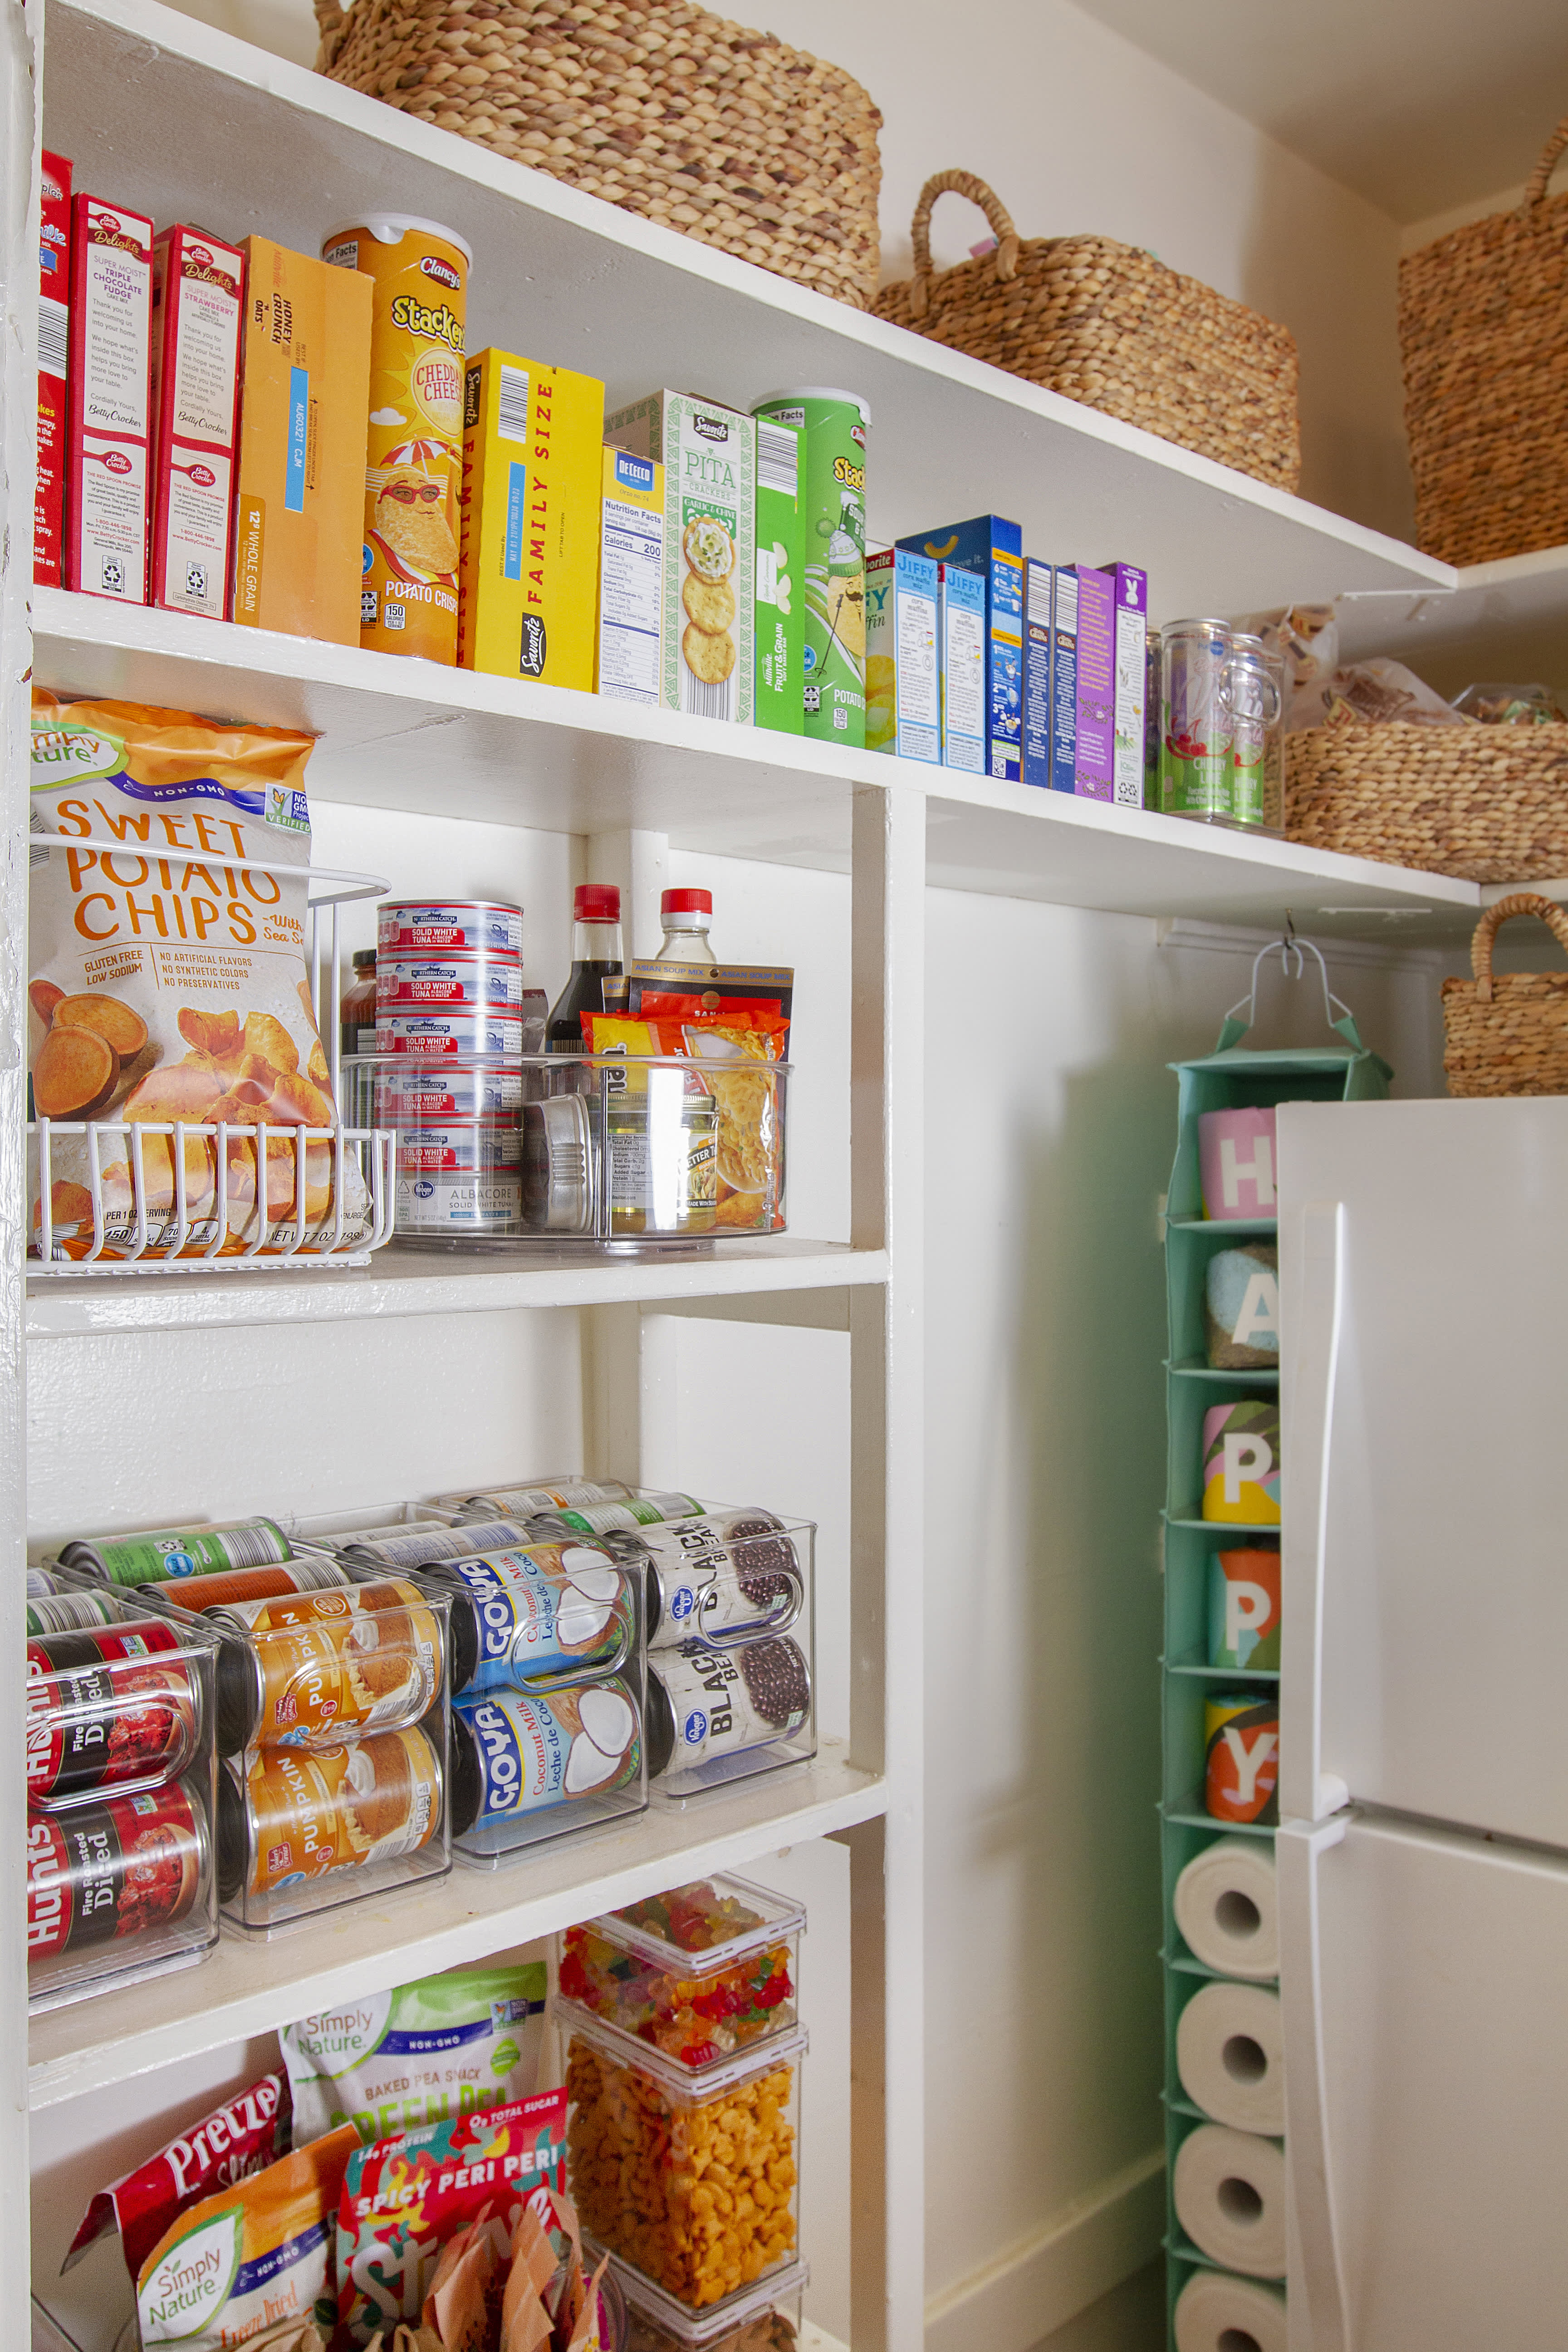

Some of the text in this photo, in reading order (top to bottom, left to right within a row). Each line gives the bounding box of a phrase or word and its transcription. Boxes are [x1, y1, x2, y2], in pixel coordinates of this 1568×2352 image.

[94, 230, 139, 254] Delights
[335, 245, 357, 257] Facts
[94, 255, 116, 269] SUPER
[420, 257, 461, 288] Clancy's
[93, 273, 142, 294] CHOCOLATE
[105, 268, 131, 282] TRIPLE
[185, 264, 232, 289] Delights
[104, 284, 131, 299] FUDGE
[187, 284, 208, 298] SUPER
[93, 298, 111, 309] Thank
[185, 293, 234, 317] STRAWBERRY
[255, 299, 263, 323] OATS
[92, 319, 118, 332] into your
[93, 309, 124, 325] welcoming
[272, 293, 282, 344] CRUNCH
[283, 299, 292, 343] HONEY
[92, 344, 134, 363] inside this box
[103, 337, 118, 348] hope
[120, 344, 138, 354] what's
[91, 365, 120, 378] more love
[92, 354, 137, 374] helps bring
[106, 379, 122, 389] table.
[91, 392, 137, 412] Cordially Yours,
[180, 400, 205, 413] Cordially
[42, 427, 51, 436] the
[535, 383, 553, 460] SIZE
[106, 458, 129, 471] Crocker
[110, 454, 126, 466] Betty
[294, 448, 303, 467] CJM
[40, 467, 54, 477] heat.
[685, 451, 736, 489] PITA
[106, 476, 122, 484] SPOON
[122, 480, 141, 489] PROMISE
[689, 482, 730, 500] CRACKERS
[605, 500, 661, 524] Nutrition Facts
[684, 498, 736, 519] GARLIC CHIVE
[36, 525, 53, 536] spray.
[95, 519, 132, 531] 1-800-446-1898
[87, 529, 140, 545] www.BettyCrocker.com
[528, 476, 549, 605] FAMILY
[605, 534, 632, 549] Calories
[34, 546, 44, 554] and
[644, 544, 661, 556] 200
[46, 559, 55, 567] are
[245, 529, 260, 612] WHOLE GRAIN
[897, 555, 934, 579] JIFFY
[947, 572, 982, 594] JIFFY
[386, 580, 457, 616] POTATO CRISPS
[388, 605, 403, 616] 150
[522, 617, 544, 673] Savoritz
[833, 689, 860, 708] POTATO
[836, 709, 846, 719] 150
[153, 783, 225, 797] NON-GMO
[57, 798, 246, 858] SWEET
[269, 814, 310, 831] VERIFIED
[66, 847, 281, 904] POTATO
[74, 890, 257, 945] CHIPS
[264, 926, 289, 942] Sea
[84, 950, 144, 972] GLUTEN FREE
[159, 952, 252, 966] NO ARTIFICIAL FLAVORS
[86, 964, 143, 985] LOW SODIUM
[162, 964, 249, 979] NO SYNTHETIC COLORS
[749, 971, 772, 980] SOUP
[177, 978, 240, 990] PRESERVATIVES
[432, 982, 456, 990] WHITE
[1220, 1136, 1275, 1207] H
[416, 1182, 432, 1196] Kroger
[106, 1211, 121, 1220] PER
[269, 1230, 289, 1241] NET
[1232, 1273, 1279, 1344] A
[1224, 1432, 1272, 1504] P
[500, 1556, 525, 1581] Milk
[513, 1552, 538, 1576] Coco
[458, 1560, 513, 1655] GOYA
[1225, 1580, 1272, 1651] P
[681, 1644, 733, 1737] BLACK
[72, 1725, 84, 1752] Fire
[689, 1715, 704, 1741] Kroger
[516, 1701, 546, 1796] Coconut Milk
[530, 1698, 562, 1793] Leche de Coco
[475, 1705, 519, 1809] GOYA
[1223, 1726, 1278, 1802] Y
[277, 1757, 319, 1854] PUMPKIN
[74, 1832, 93, 1917] Fire Roasted
[88, 1831, 113, 1910] Diced
[306, 2011, 374, 2036] Simply
[298, 2035, 363, 2057] Nature
[409, 2035, 461, 2050] NON-GMO
[364, 2078, 410, 2102] BAKED
[415, 2073, 441, 2087] PEA
[490, 2105, 523, 2123] TOTAL
[524, 2095, 560, 2113] SUGAR
[382, 2132, 434, 2156] PROTEIN
[356, 2146, 558, 2218] SPICY PERI PERI
[256, 2244, 299, 2278] NON-GMO
[157, 2247, 221, 2299] Simply
[148, 2277, 217, 2326] Nature
